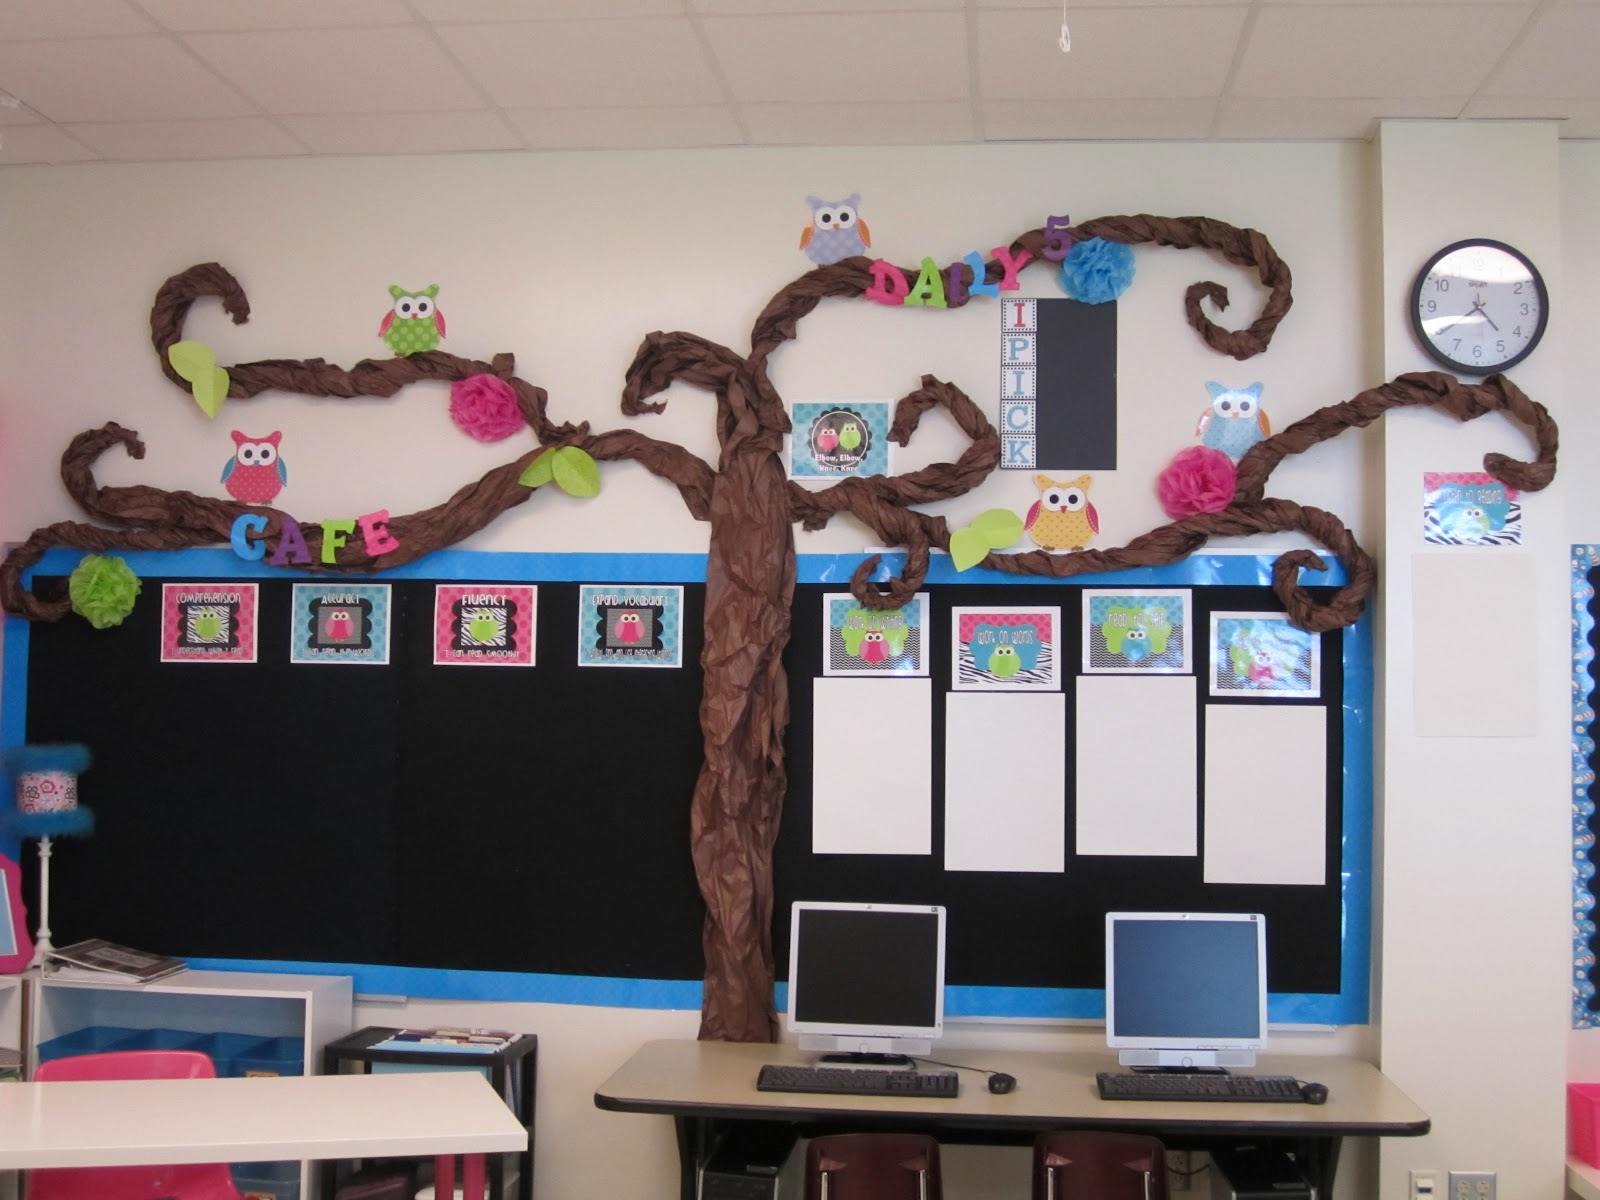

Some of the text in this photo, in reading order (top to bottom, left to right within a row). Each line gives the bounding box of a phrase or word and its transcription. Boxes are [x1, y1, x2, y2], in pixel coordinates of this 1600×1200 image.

[865, 214, 1073, 308] DAILY 5
[1435, 279, 1449, 292] 10
[1513, 282, 1523, 295] 2
[1427, 300, 1437, 313] 9
[1519, 303, 1529, 316] 3
[1512, 325, 1522, 338] 4
[1452, 338, 1462, 351] 7
[1496, 340, 1505, 353] 5
[1472, 345, 1482, 358] 6
[815, 453, 864, 462] Elbow, Elbow,
[840, 464, 858, 472] Knee
[230, 509, 400, 566] CAFE
